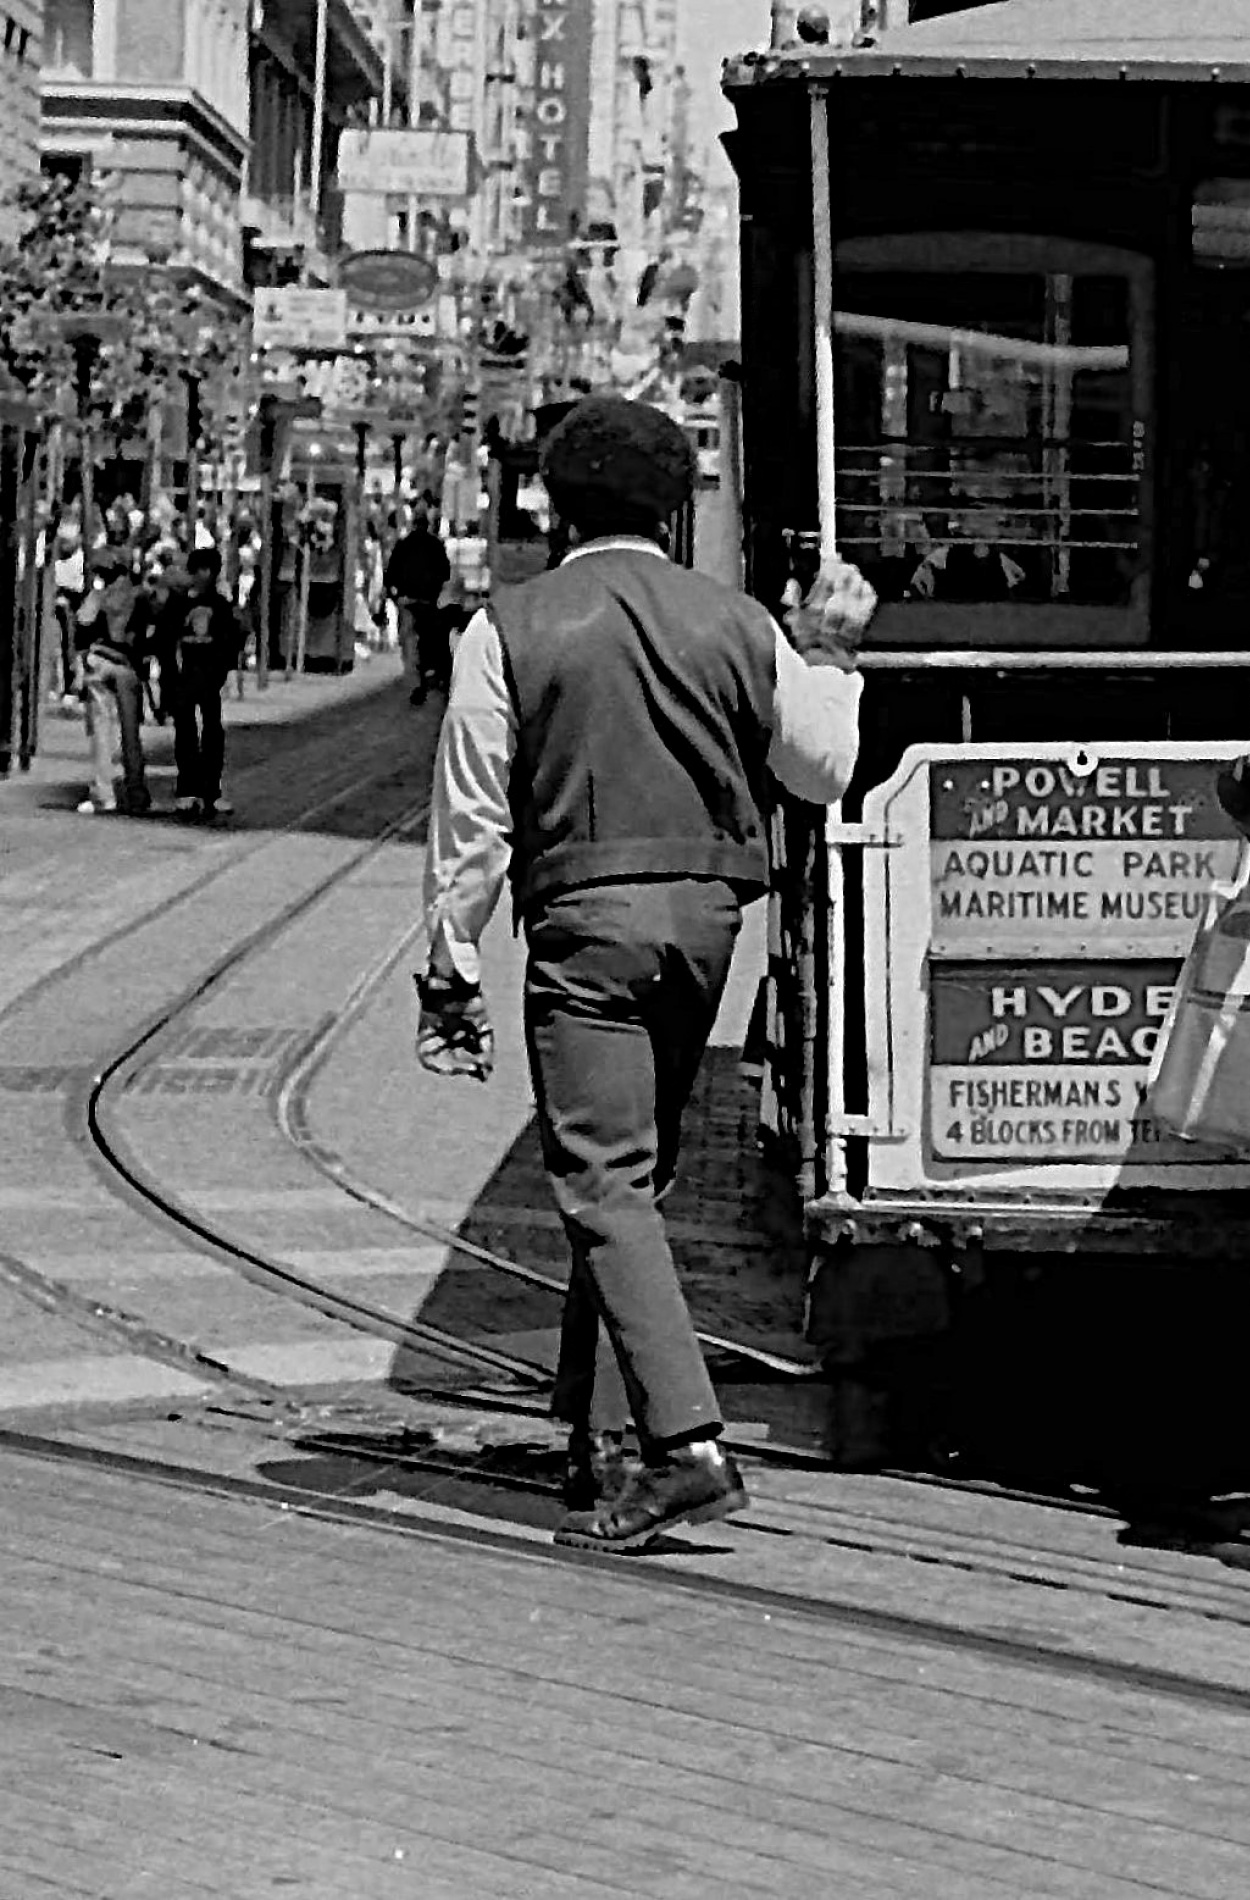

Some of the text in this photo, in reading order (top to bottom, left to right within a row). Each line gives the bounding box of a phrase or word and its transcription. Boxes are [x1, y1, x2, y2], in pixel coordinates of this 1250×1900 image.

[537, 61, 567, 231] HOTEL
[992, 766, 1170, 797] POWELL
[968, 799, 1192, 838] AND MARKET
[943, 851, 1216, 880] AQUATIC PARK
[940, 890, 1090, 919] MARITIME
[991, 985, 1177, 1018] HYDE
[967, 1023, 1161, 1063] AND BEAC
[946, 1120, 964, 1145] 4
[970, 1119, 1056, 1145] BLOCKS
[1063, 1119, 1121, 1145] FROM
